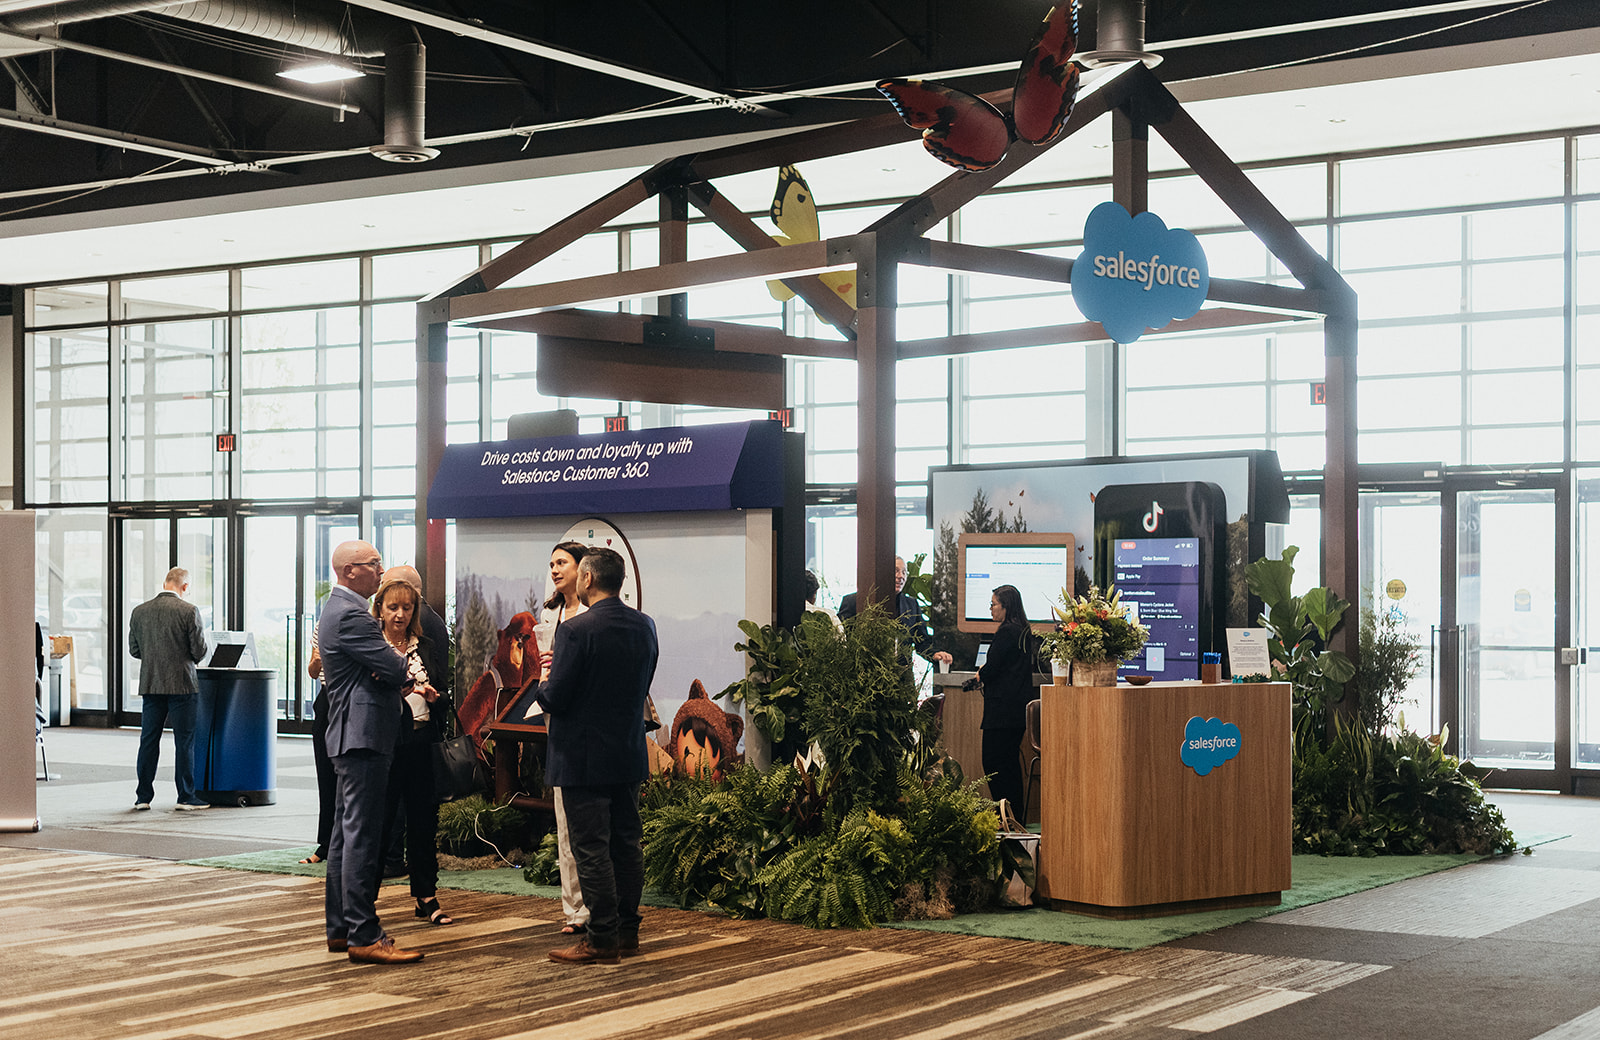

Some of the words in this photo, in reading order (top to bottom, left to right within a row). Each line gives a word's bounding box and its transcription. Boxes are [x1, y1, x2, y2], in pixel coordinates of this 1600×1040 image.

[1093, 251, 1200, 291] salesforce
[606, 417, 626, 432] EXIT
[218, 435, 235, 452] EXIT
[481, 451, 510, 466] Drive
[511, 448, 541, 464] costs
[542, 447, 575, 462] down
[576, 443, 603, 460] and
[602, 440, 646, 461] loyalty
[646, 442, 664, 459] up
[667, 437, 693, 454] with
[502, 468, 561, 485] Salesforce
[563, 465, 622, 482] Customer
[621, 461, 650, 478] 360.
[1188, 735, 1237, 752] salesforce
